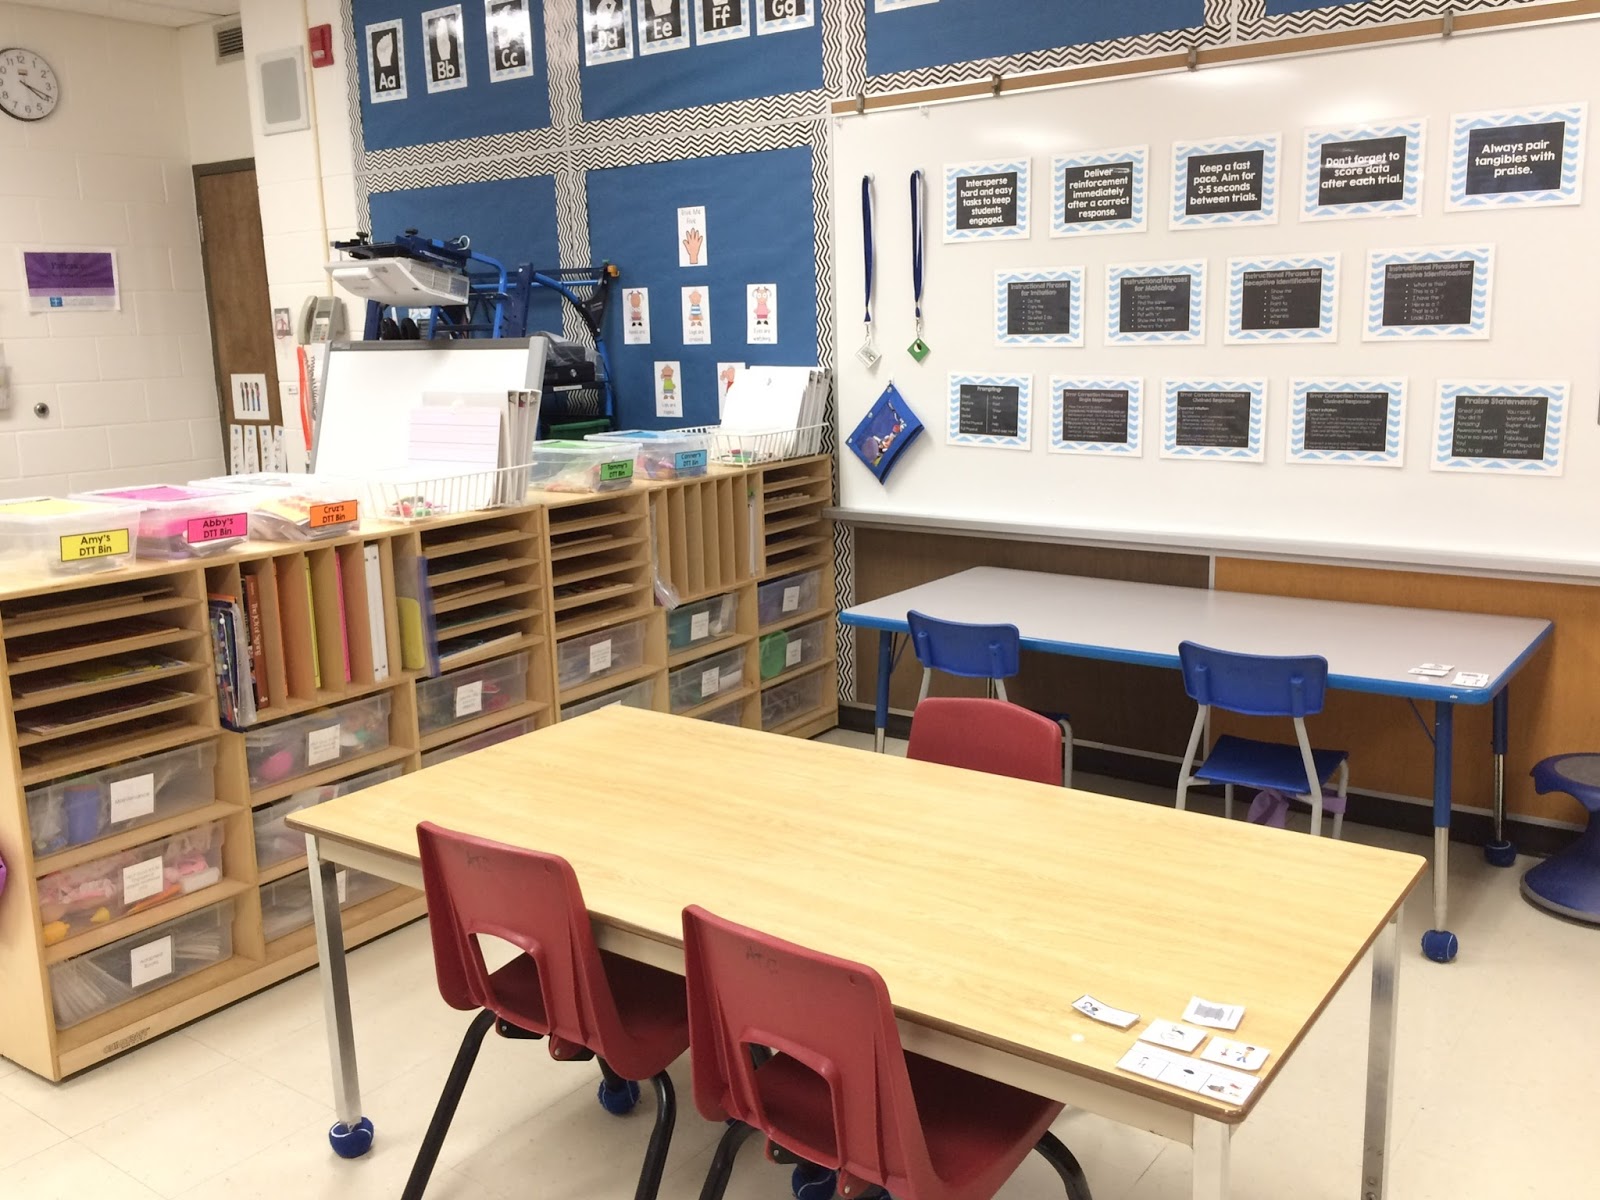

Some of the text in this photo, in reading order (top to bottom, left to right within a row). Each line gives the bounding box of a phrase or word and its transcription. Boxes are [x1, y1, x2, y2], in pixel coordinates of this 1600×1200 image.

[772, 0, 797, 17] Gg
[712, 5, 731, 28] Ff
[654, 19, 672, 39] Ee
[17, 56, 25, 64] 12
[501, 49, 518, 67] Cc
[33, 60, 36, 68] 1
[41, 70, 46, 78] 2
[437, 62, 454, 79] Bb
[379, 73, 396, 89] Aa
[2, 91, 8, 99] 8
[1482, 140, 1550, 153] Always pair
[1326, 152, 1400, 167] Don't forget to
[1475, 151, 1555, 166] tangibles with
[1200, 164, 1222, 173] Keep
[1233, 161, 1250, 170] fast
[1335, 165, 1389, 176] score data
[1494, 166, 1533, 178] praise.
[1084, 169, 1113, 178] Deliver
[1194, 172, 1255, 186] pace. Aim for
[966, 178, 1007, 187] Intersperse
[1070, 176, 1128, 189] reinforcement
[1322, 174, 1401, 188] after each trial.
[961, 189, 978, 197] hard
[995, 187, 1013, 195] easy
[1073, 187, 1124, 198] immediately
[1198, 183, 1250, 194] 3-5 seconds
[963, 198, 982, 206] tasks
[1068, 200, 1088, 209] after
[1097, 197, 1129, 206] correct
[1190, 193, 1257, 205] between trials.
[972, 206, 1001, 215] students
[1079, 209, 1117, 218] response.
[969, 215, 1004, 225] engaged.
[324, 505, 344, 513] Cruz's
[203, 518, 233, 528] Abby's
[323, 513, 345, 523] DTT Bin
[204, 528, 231, 538] DTT Bin
[81, 535, 110, 545] Amy's
[80, 545, 112, 556] DTT Bin
